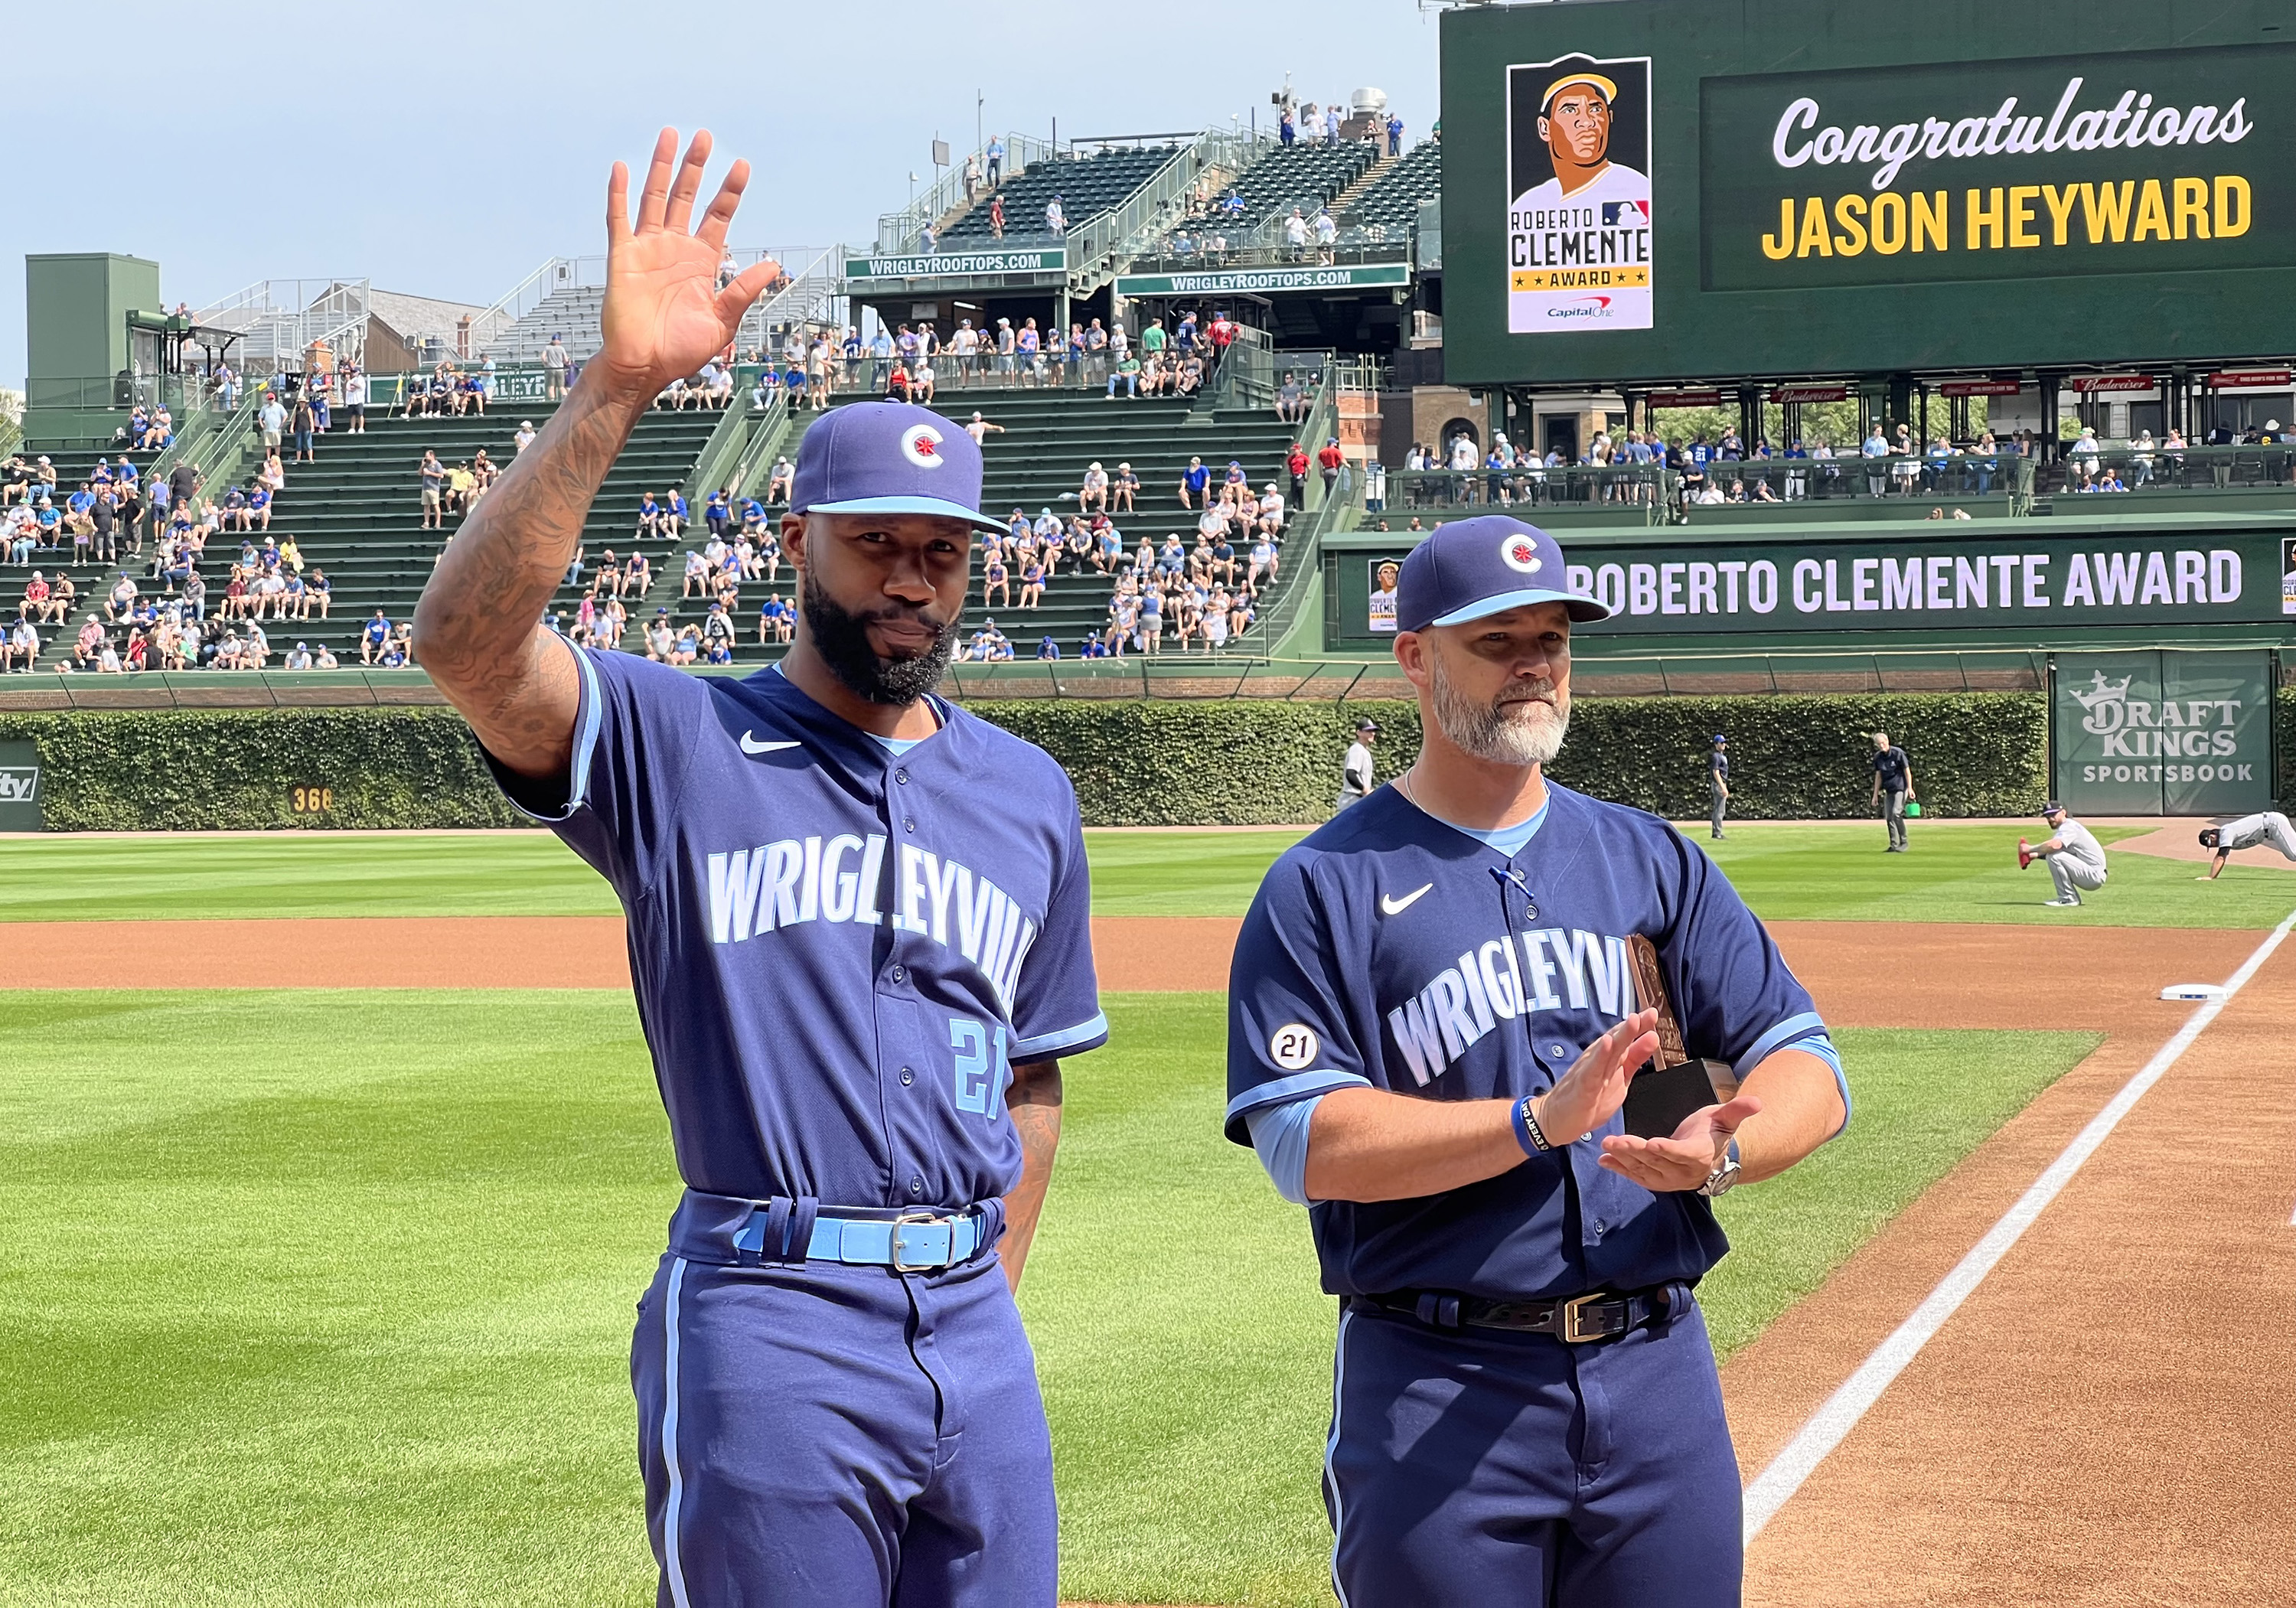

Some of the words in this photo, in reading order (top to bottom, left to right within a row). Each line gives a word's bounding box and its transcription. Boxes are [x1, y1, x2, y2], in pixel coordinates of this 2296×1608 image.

[1773, 77, 2253, 191] Congratulations
[1512, 208, 1593, 230] ROBERTO
[1762, 190, 1949, 260] JASON
[1966, 174, 2252, 250] HEYWARD
[1512, 229, 1649, 267] CLEMENTE
[1550, 270, 1611, 287] AWARD
[1778, 390, 1840, 403] Budweiser
[2081, 378, 2146, 391] Budweiser
[1567, 560, 1779, 616] ROBERTO
[1792, 555, 2051, 613] CLEMENTE
[2062, 550, 2242, 607] AWARD
[1371, 604, 1397, 614] CLEME
[2082, 700, 2242, 735] DRAFT
[2102, 728, 2237, 757] KINGS
[2082, 764, 2253, 782] SPORTSBOOK
[294, 788, 332, 811] 368
[1387, 928, 1634, 1088] WRIGLEYVI
[1280, 1034, 1308, 1058] 21
[949, 1018, 1007, 1120] 21
[1525, 1118, 1545, 1145] EVERY
